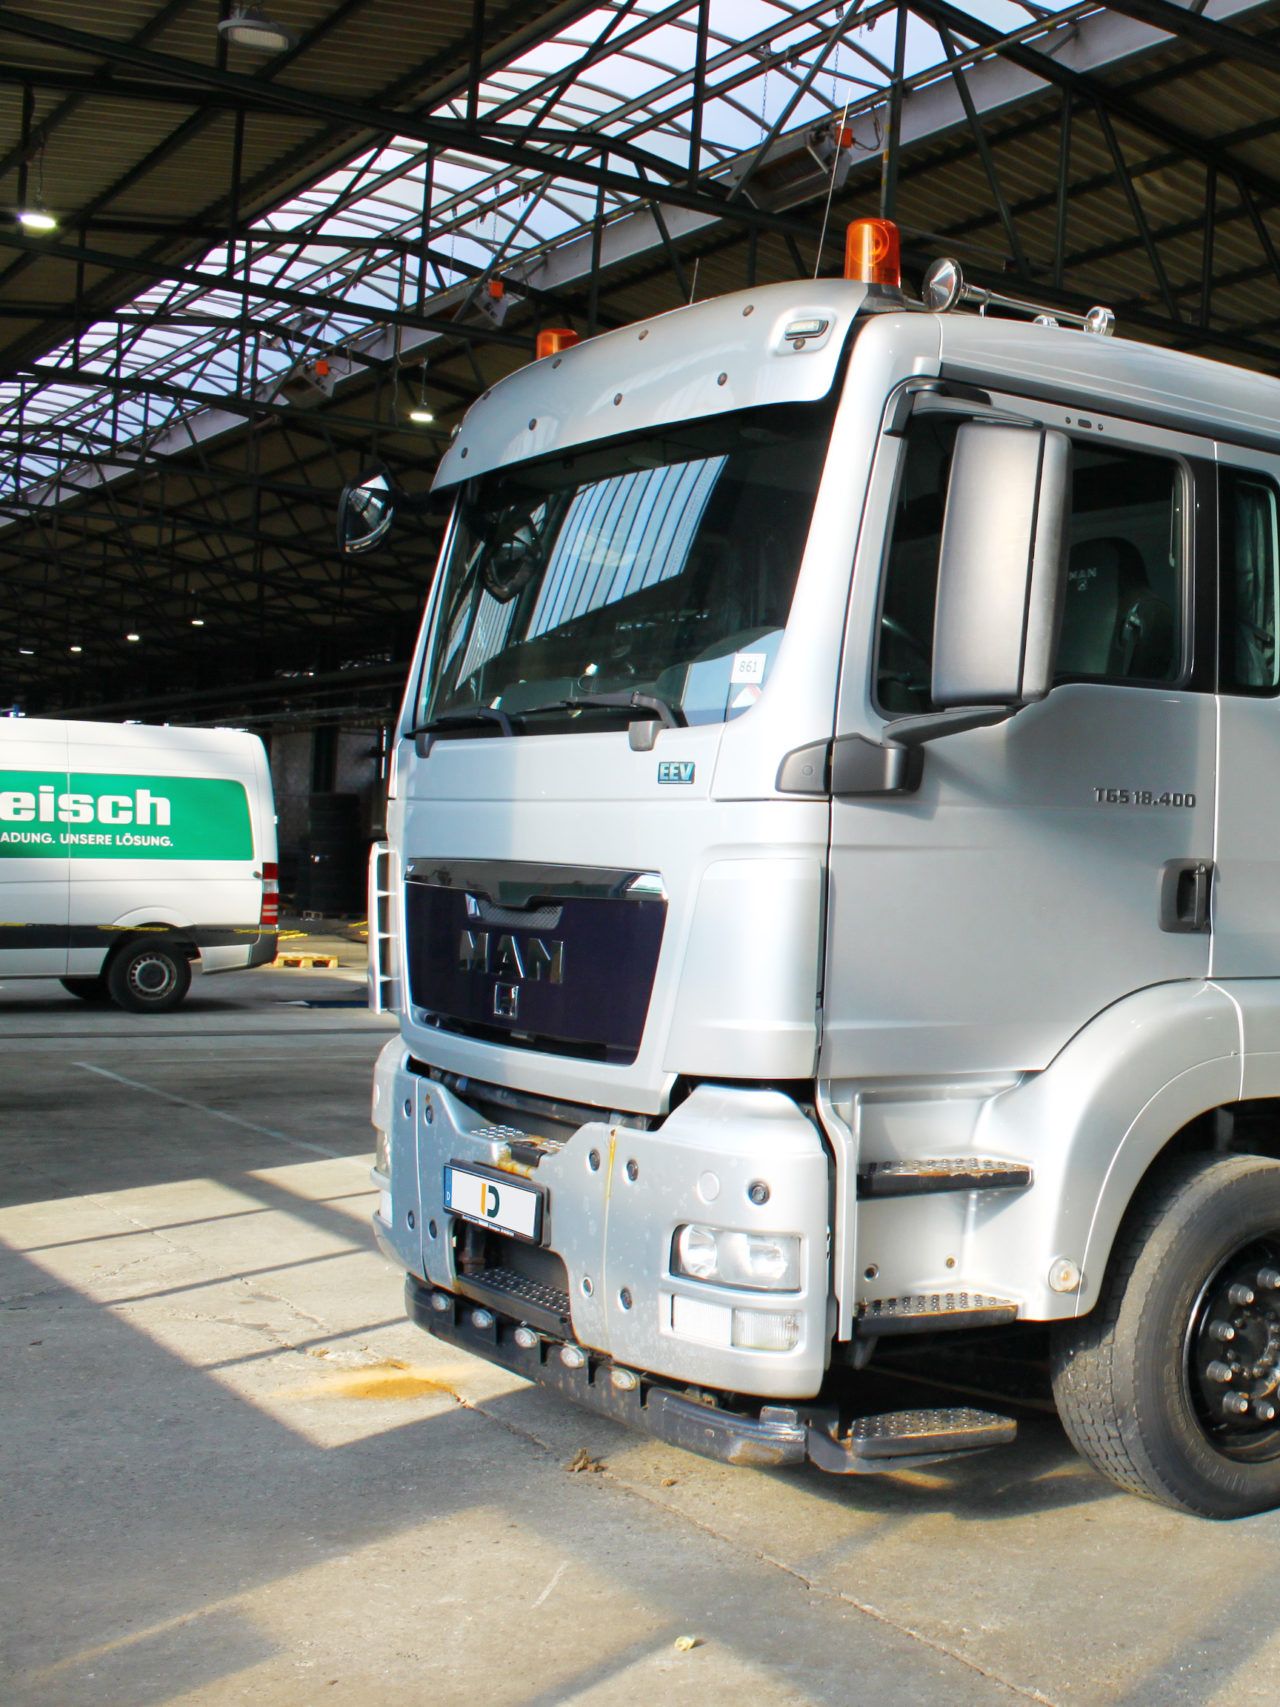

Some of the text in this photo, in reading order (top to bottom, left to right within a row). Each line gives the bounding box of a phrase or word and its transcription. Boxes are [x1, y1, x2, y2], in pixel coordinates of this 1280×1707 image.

[739, 661, 757, 673] 861
[659, 762, 695, 781] EEV
[0, 785, 171, 826] eisch
[60, 833, 112, 846] UNSERE
[115, 832, 174, 847] LÖSUNG.
[458, 929, 564, 984] MAN
